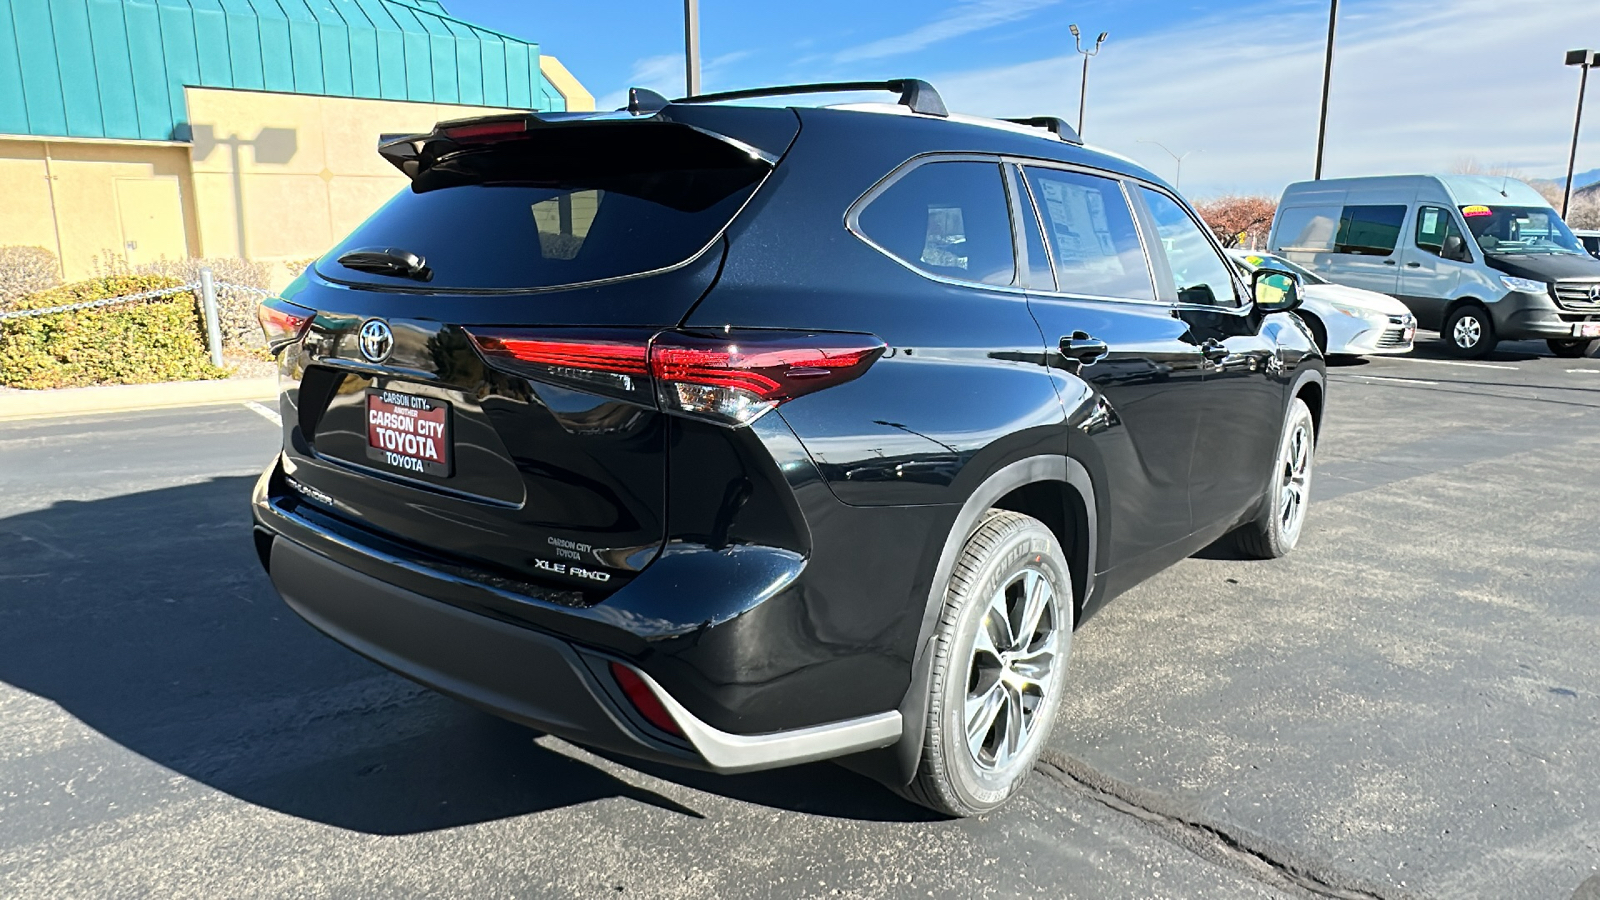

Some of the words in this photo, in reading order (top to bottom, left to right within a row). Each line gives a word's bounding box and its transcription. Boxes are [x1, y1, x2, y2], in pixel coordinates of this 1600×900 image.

[383, 392, 409, 406] CARSON
[411, 397, 426, 409] CITY
[394, 407, 418, 417] ANOTHER
[369, 410, 414, 432] CARSON
[418, 420, 444, 438] CITY
[376, 427, 438, 459] TOYOTA
[386, 451, 424, 473] TOYOTA
[548, 537, 575, 549] CARSON
[576, 542, 592, 553] CITY
[556, 547, 581, 560] TOYOTA
[534, 558, 566, 574] XLE
[570, 567, 610, 582] RWD
